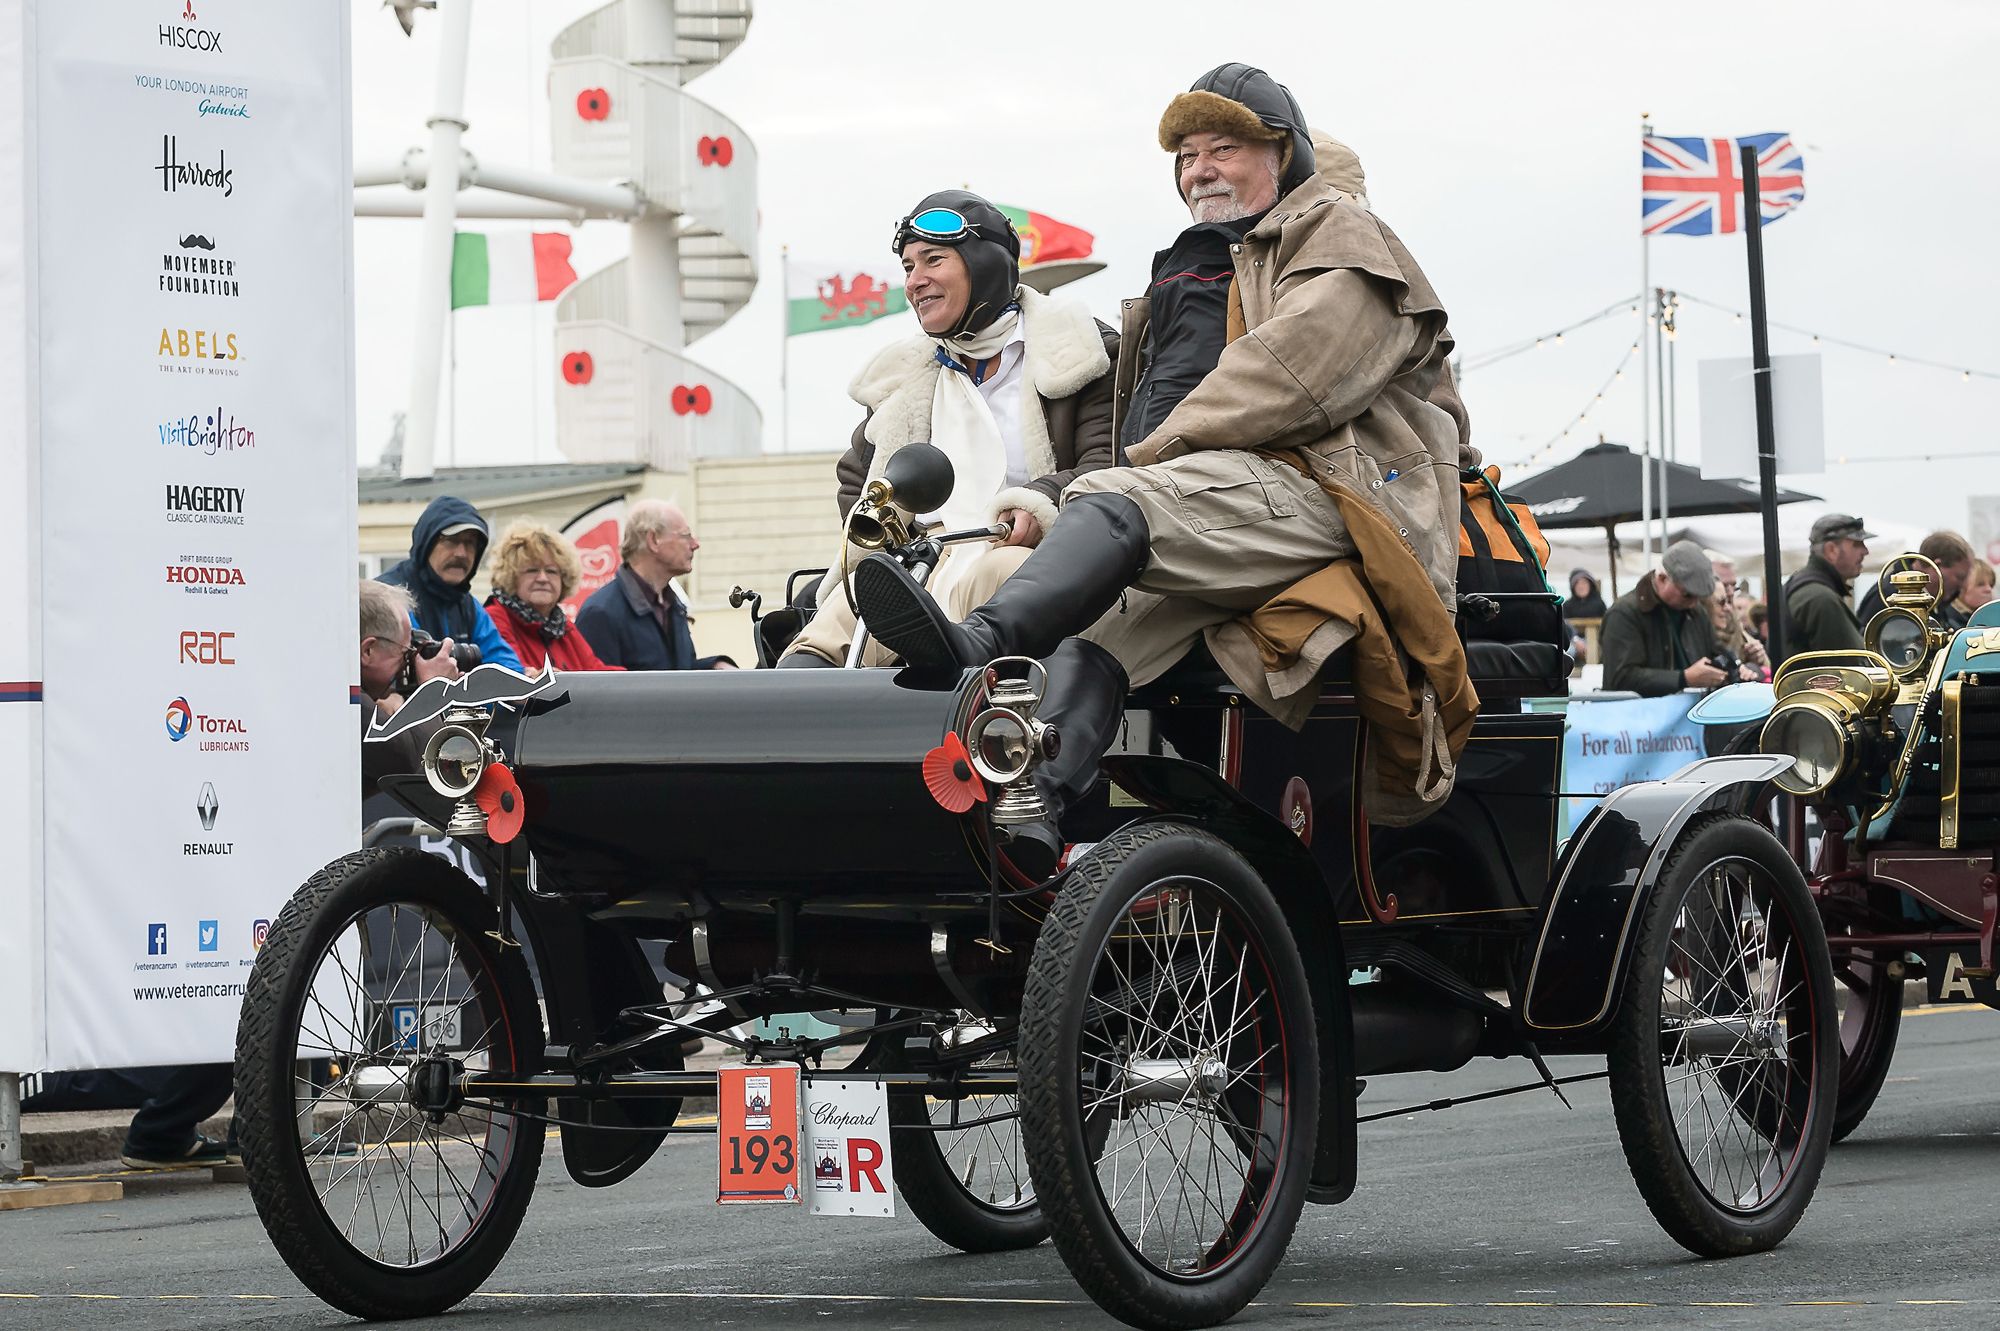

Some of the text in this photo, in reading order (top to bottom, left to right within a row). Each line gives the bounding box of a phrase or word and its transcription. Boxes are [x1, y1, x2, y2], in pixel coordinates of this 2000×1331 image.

[158, 24, 223, 53] HISCOX
[135, 75, 248, 100] YOUR LONDON AIRPORT
[198, 99, 251, 119] Gatwick
[154, 134, 233, 198] Harrods
[163, 254, 234, 276] MOVEMBER
[159, 275, 239, 297] FOUNDATION
[158, 328, 239, 361] ABELS
[159, 364, 239, 377] THE ART OF MOVING
[166, 484, 245, 513] HAGERTY
[166, 513, 244, 525] CLASSIC CAR INSURANCE
[195, 555, 214, 564] BRIDGE
[215, 556, 233, 564] GROUP
[166, 566, 246, 585] HONDA
[184, 586, 228, 595] Redhill & Gatwick
[199, 741, 250, 752] LUBRICANTS
[1581, 732, 1610, 757] For
[1614, 730, 1633, 755] all
[183, 842, 234, 856] RENAULT
[133, 983, 246, 1001] www.veterancarru
[809, 1101, 881, 1130] Chopard
[729, 1134, 795, 1175] 193
[846, 1137, 887, 1194] R
